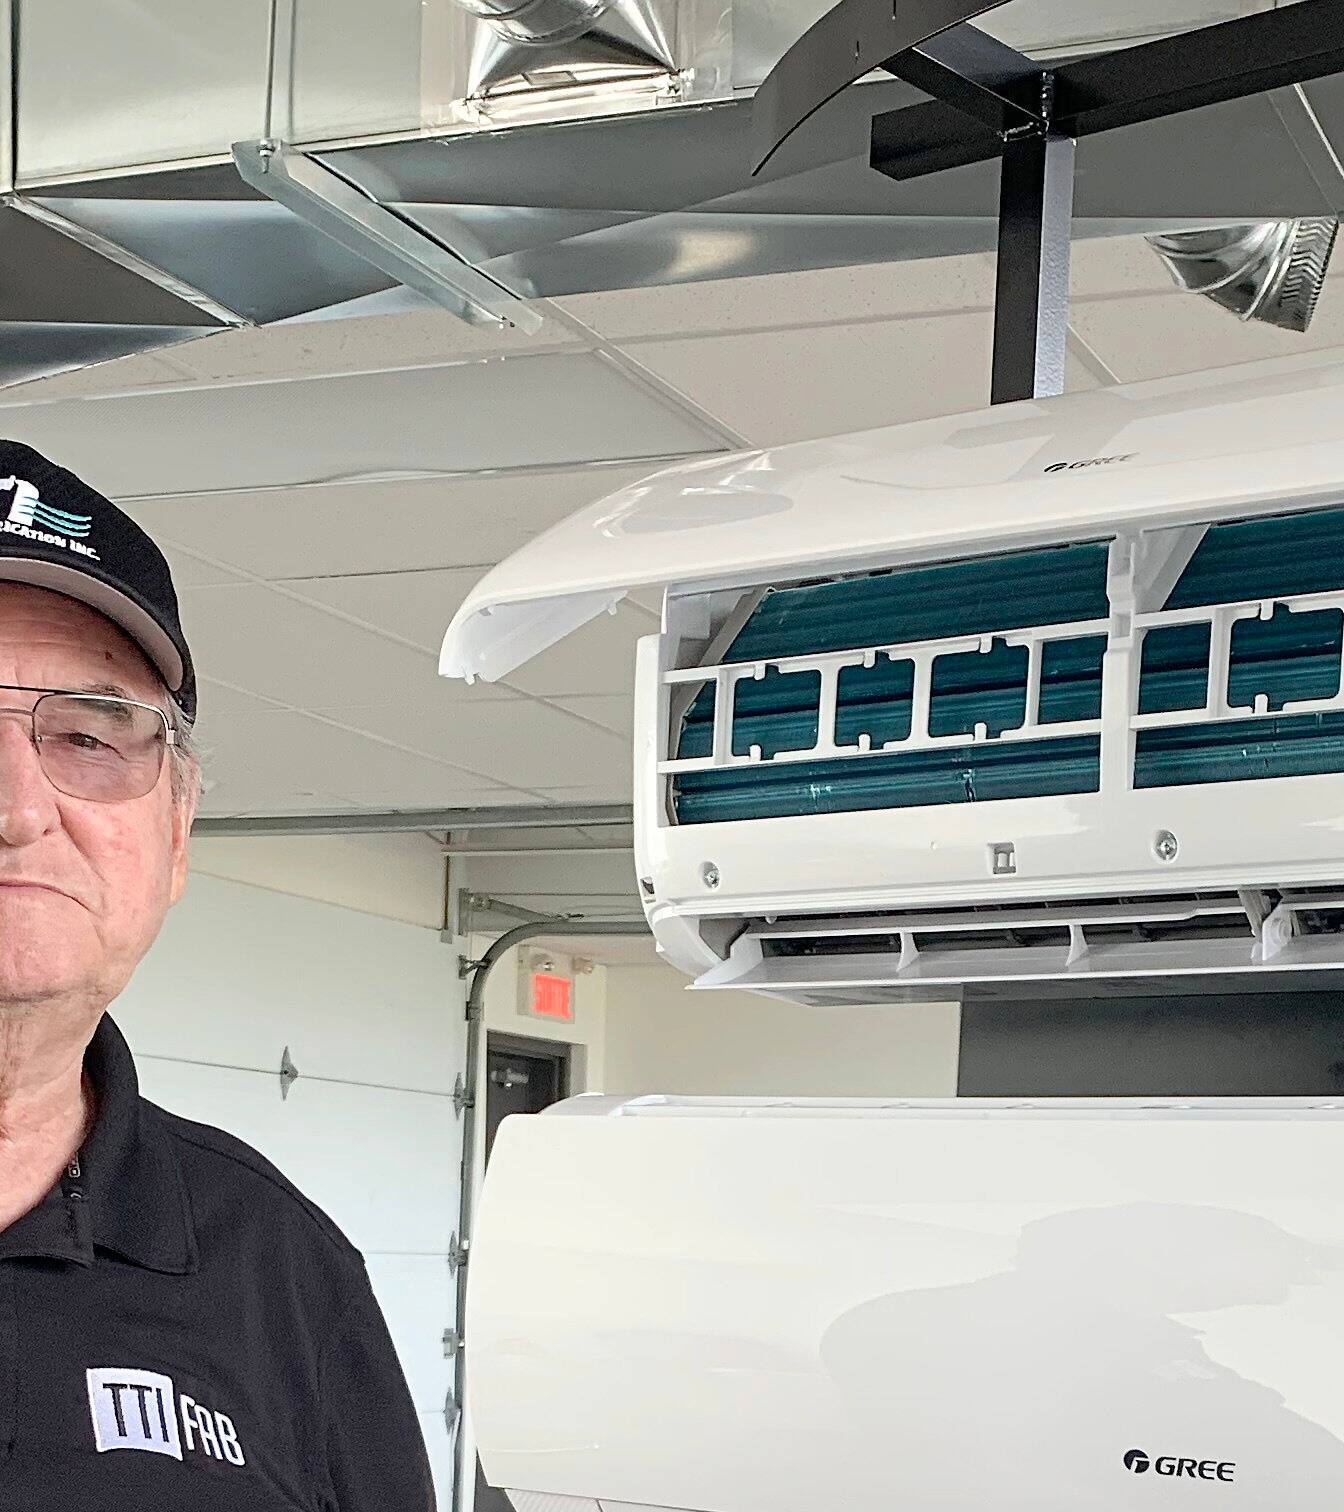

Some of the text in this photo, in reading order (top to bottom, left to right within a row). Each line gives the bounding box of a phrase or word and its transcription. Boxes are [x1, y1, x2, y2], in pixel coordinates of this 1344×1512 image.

[102, 1382, 246, 1466] TTI FAB
[1155, 1456, 1236, 1482] GREE
